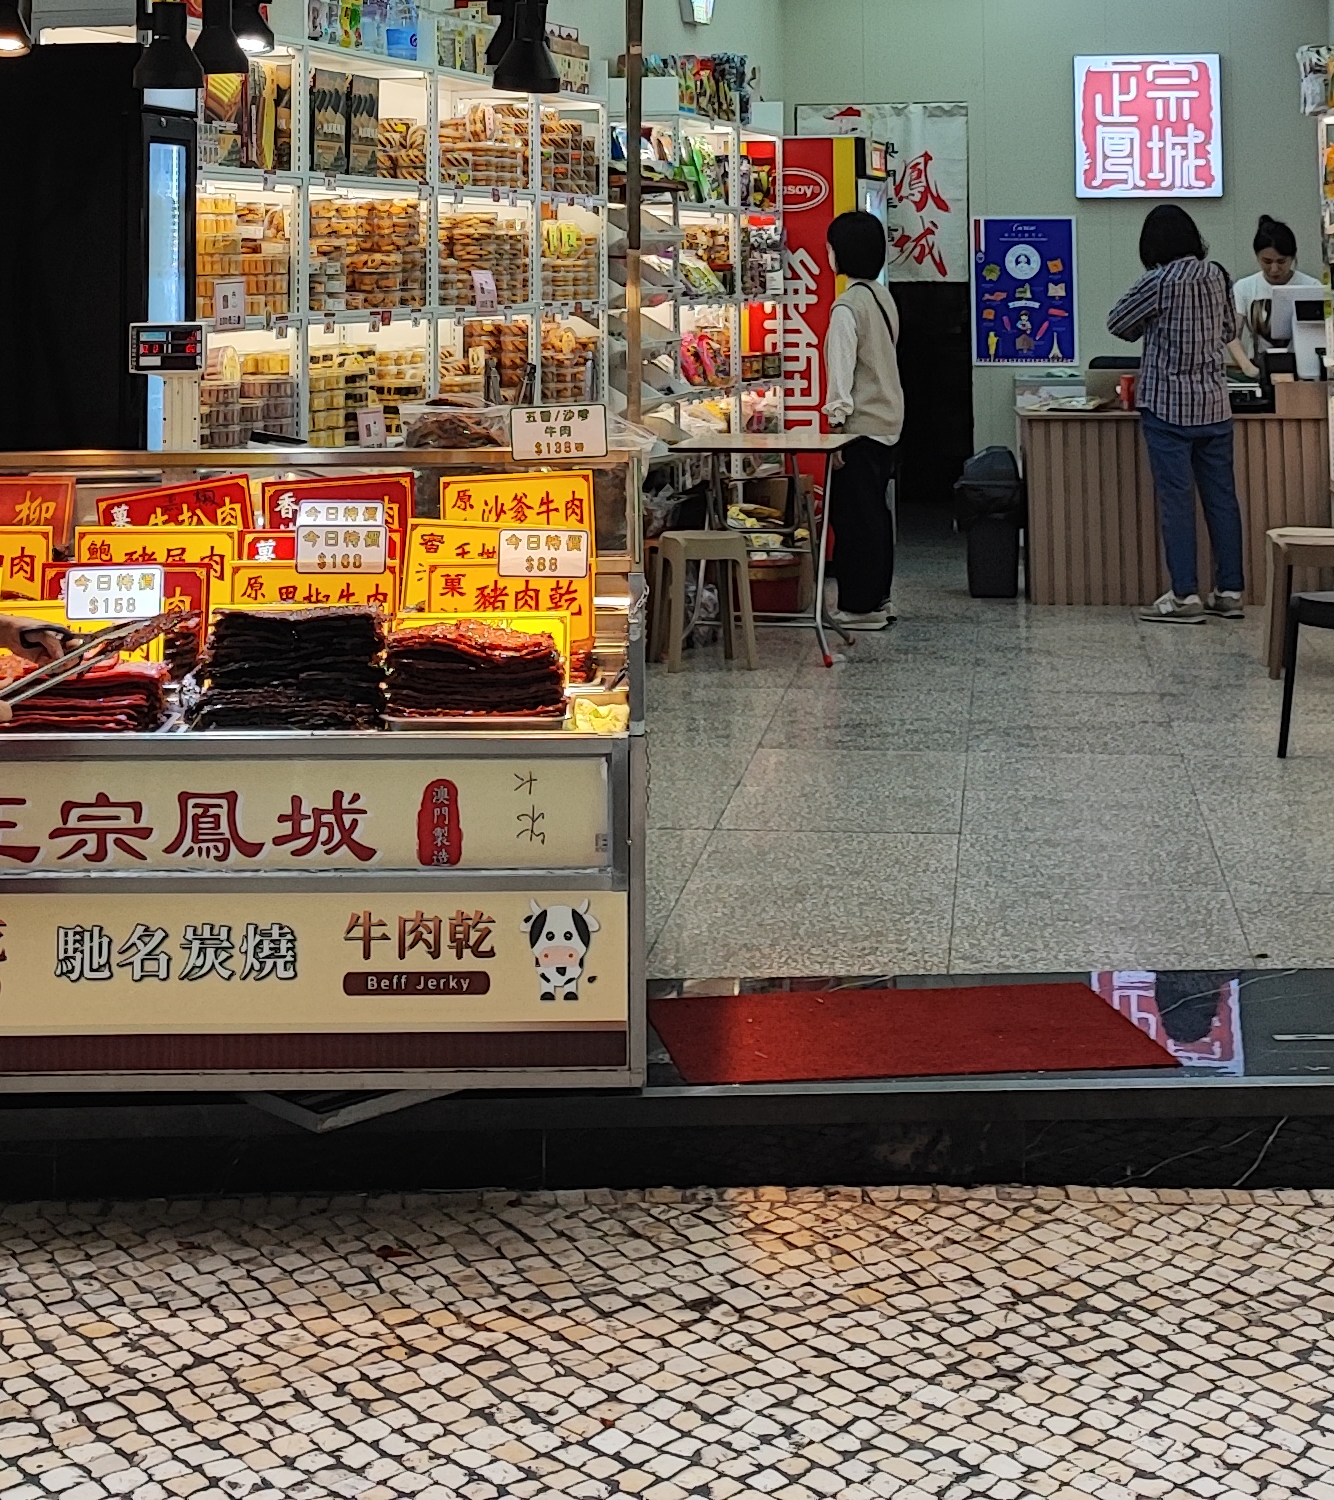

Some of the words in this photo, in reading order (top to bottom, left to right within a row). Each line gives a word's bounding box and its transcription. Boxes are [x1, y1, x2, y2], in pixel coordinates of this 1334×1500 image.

[544, 425, 572, 438] 牛肉
[302, 530, 381, 548] 今日特價
[505, 534, 583, 551] 今日特價
[525, 556, 558, 573] $88
[74, 572, 156, 592] 今日特價
[431, 785, 451, 866] 澳門製造
[343, 910, 496, 960] 牛肉乾
[54, 923, 298, 983] 馳名炭燒
[367, 974, 408, 990] Beff
[416, 974, 470, 991] Jerky
